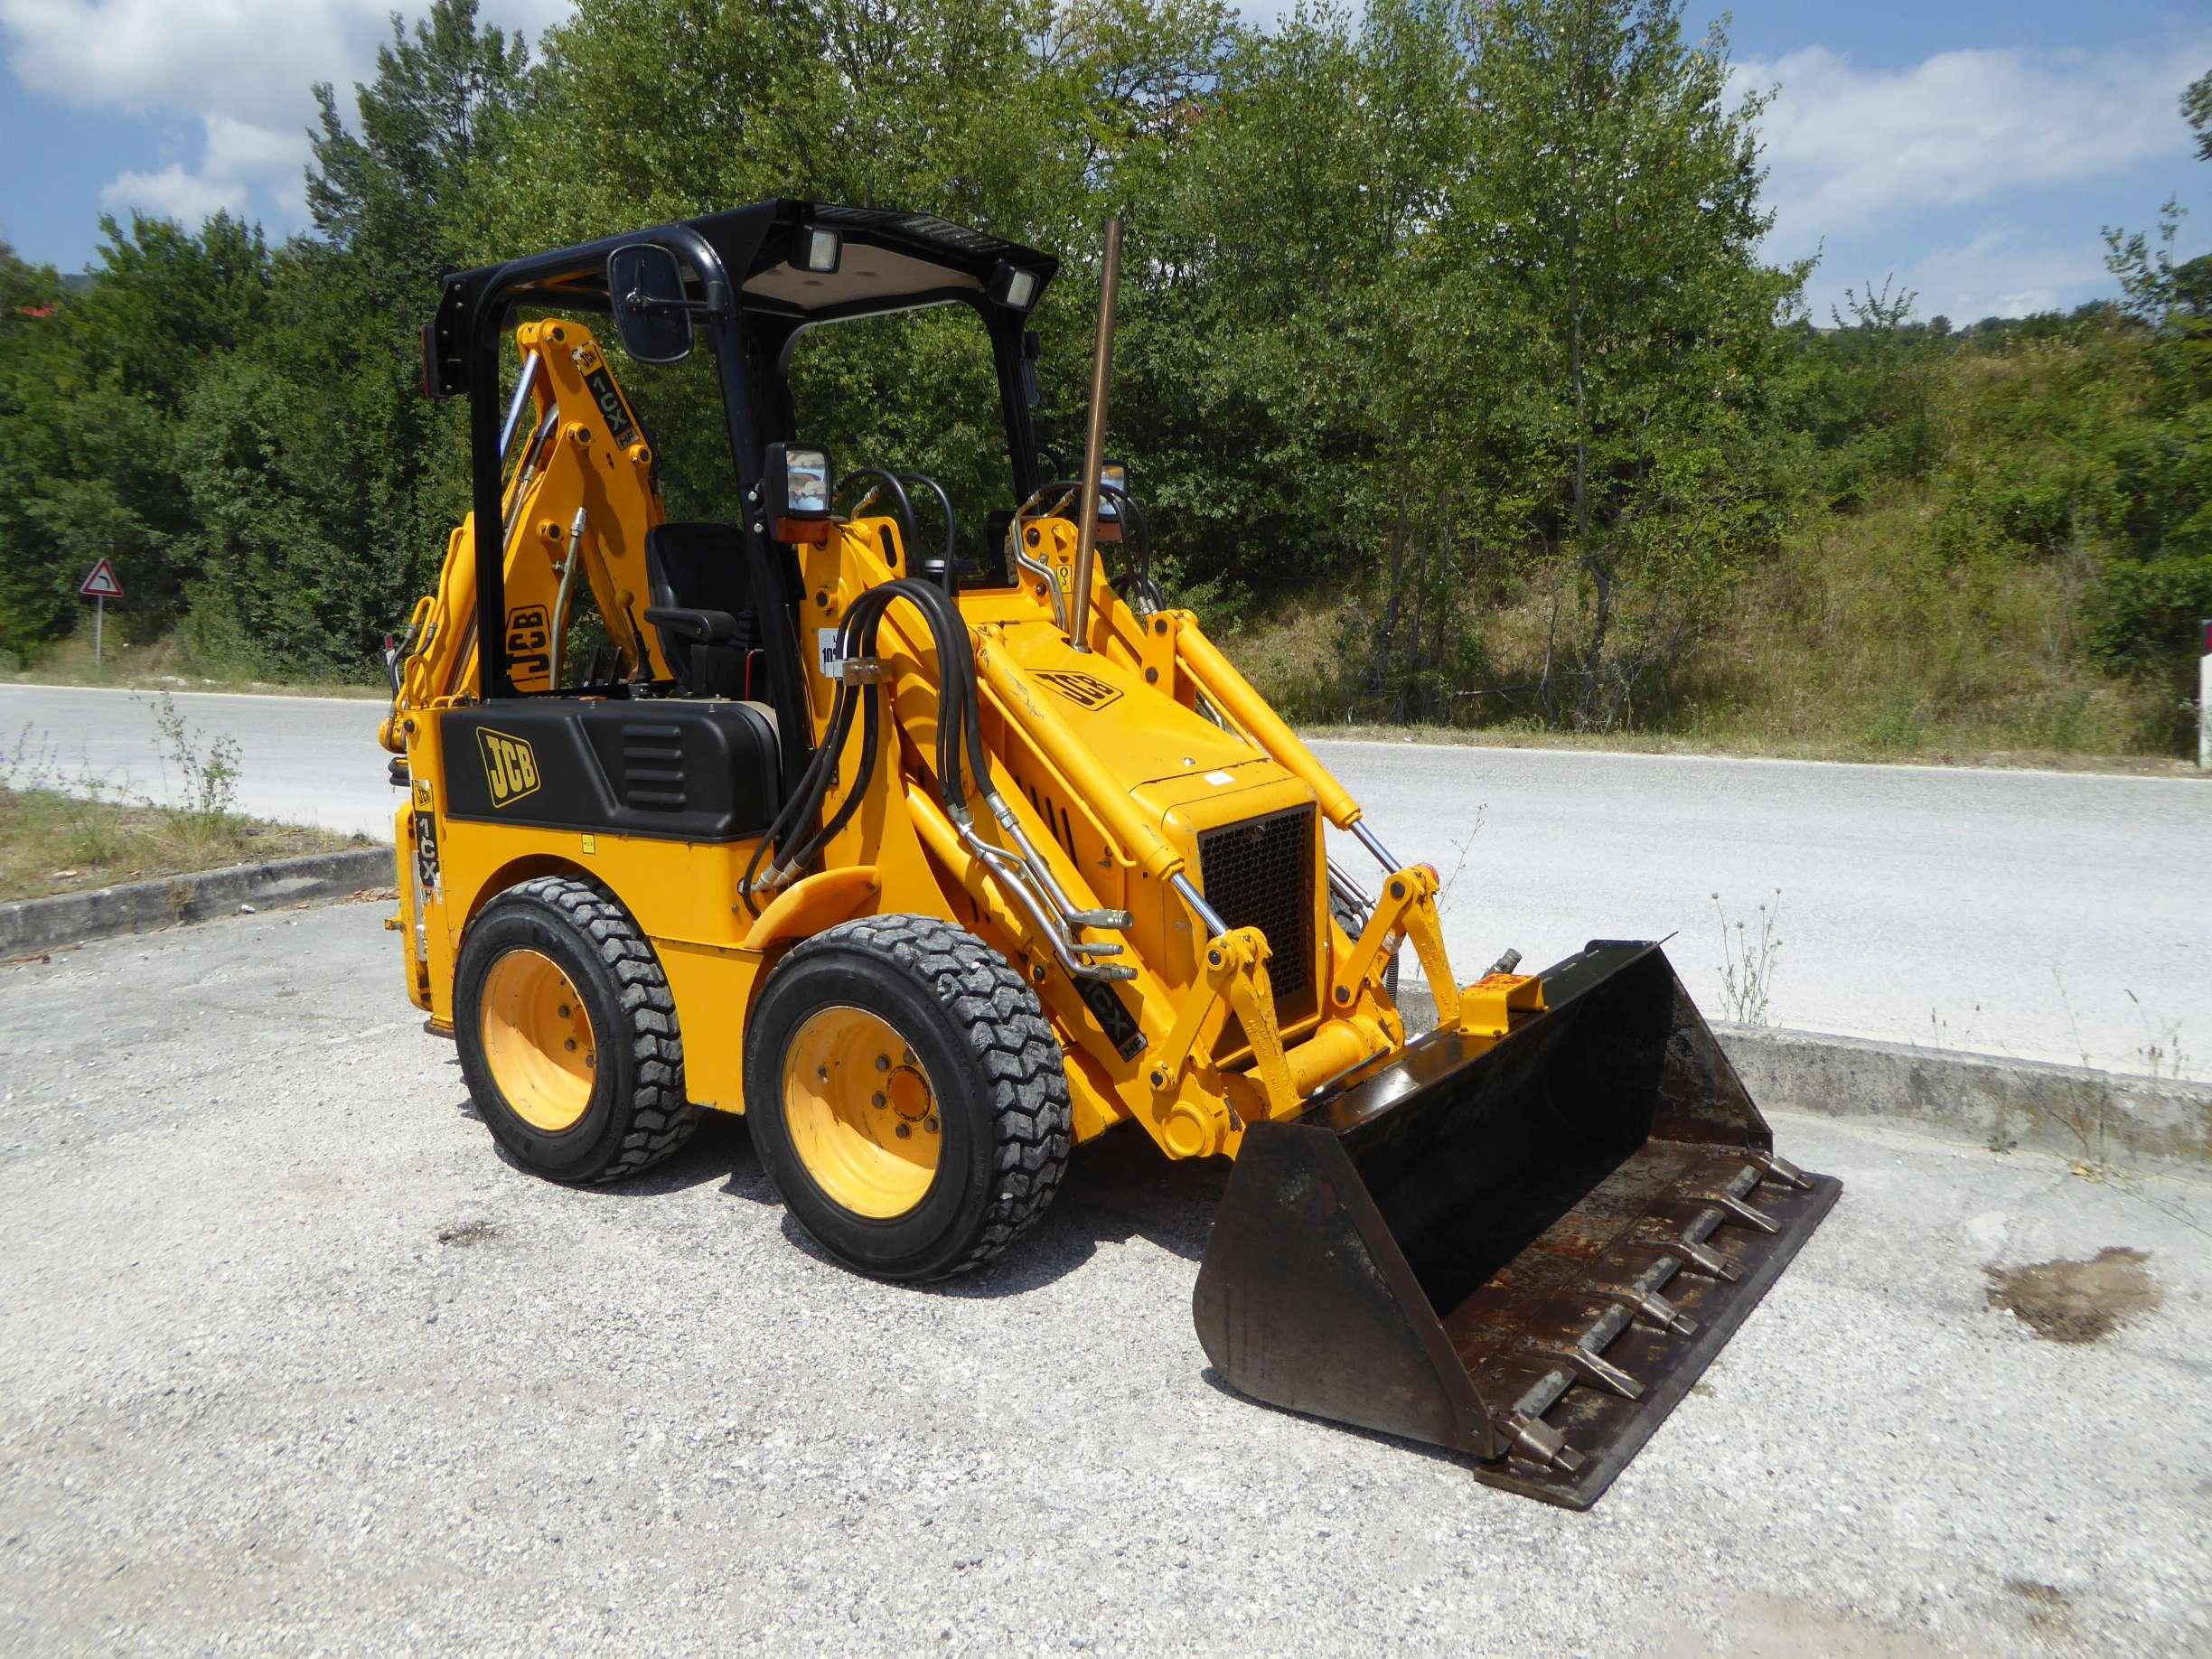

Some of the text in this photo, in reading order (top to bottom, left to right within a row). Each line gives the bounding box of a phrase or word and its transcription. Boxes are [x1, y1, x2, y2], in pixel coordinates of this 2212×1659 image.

[592, 377, 628, 431] 1CX
[506, 612, 549, 673] JCB
[1034, 673, 1113, 705] JCB
[485, 735, 536, 798] JCB
[419, 818, 436, 879] 1CX
